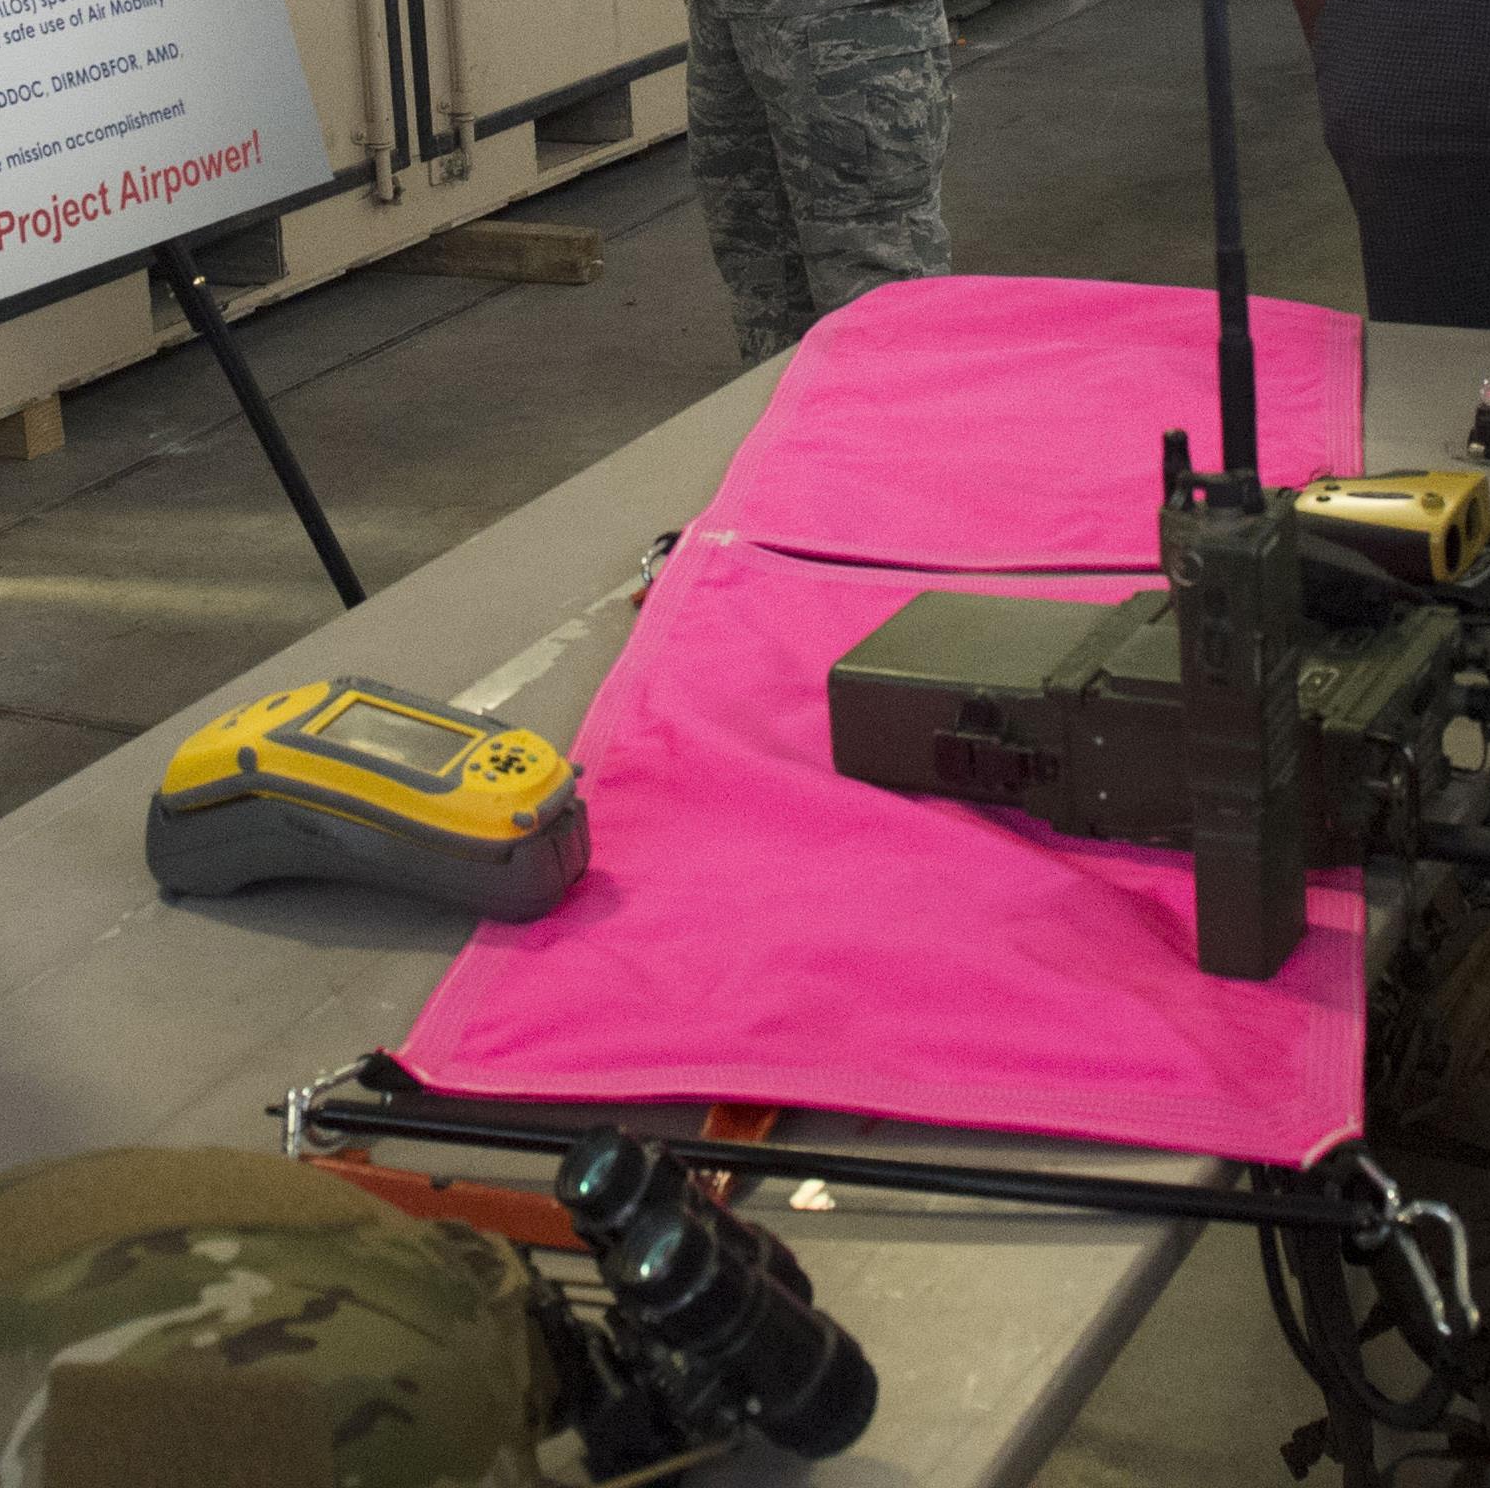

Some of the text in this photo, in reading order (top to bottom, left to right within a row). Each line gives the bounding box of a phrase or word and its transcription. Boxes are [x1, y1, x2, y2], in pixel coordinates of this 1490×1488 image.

[3, 22, 36, 45] safe
[39, 16, 65, 35] use
[69, 9, 83, 27] of
[87, 2, 106, 23] Air
[51, 54, 144, 94] DIRMOBFOR,
[146, 42, 184, 66] AMD,
[6, 139, 63, 169] mission
[65, 98, 186, 150] accomplishment
[119, 128, 264, 210] Airpower!
